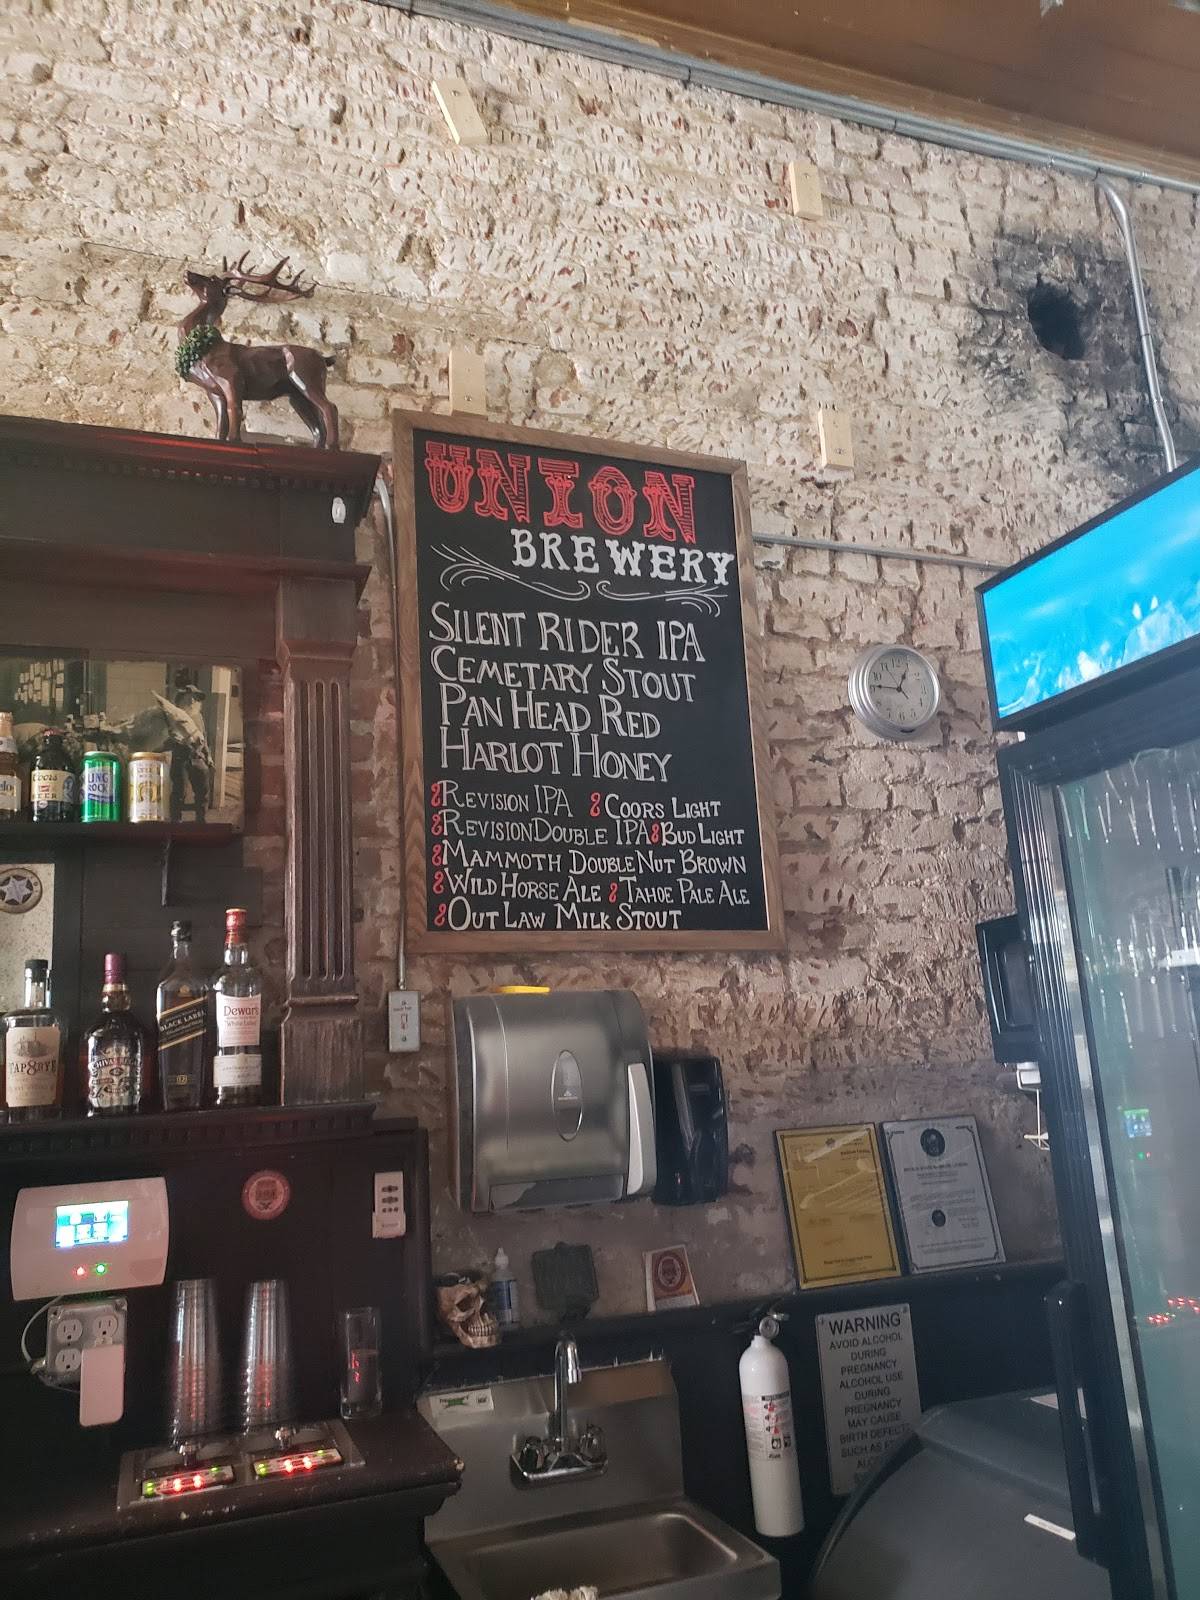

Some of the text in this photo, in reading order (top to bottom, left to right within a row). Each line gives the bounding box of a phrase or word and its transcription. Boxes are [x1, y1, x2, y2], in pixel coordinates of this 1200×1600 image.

[425, 441, 696, 544] UNION
[510, 528, 734, 586] BREWERY
[429, 601, 706, 662] SILENT RIDER IPA
[430, 645, 697, 702] CEMETARY STOUT
[440, 683, 661, 739] PAN HEAD RED
[440, 725, 673, 783] HARLOT HONEY
[440, 780, 573, 818] REVISION IPA
[604, 793, 722, 819] COORS LIGHT
[442, 808, 650, 845] REVISION DOUBLE IPA
[661, 824, 745, 845] BUD LIGHT
[442, 839, 747, 875] MAMMOTH DOUBLE NUT BROWN
[445, 868, 602, 902] WILD HORSE ALE
[618, 876, 750, 905] TAHOE PALE ALE
[447, 896, 682, 931] OUT LAW MILK STOUT
[829, 1312, 901, 1336] WARNING
[829, 1332, 903, 1350] AVOID ALCOHOL
[851, 1347, 887, 1361] DURING
[840, 1371, 904, 1389] ALCOHOL USE
[841, 1360, 897, 1376] PREGNANCY
[855, 1386, 891, 1400] DURING
[845, 1398, 902, 1416] PREGNANCY
[848, 1412, 900, 1428] MAY CAUSE
[840, 1430, 868, 1444] BIRTH
[841, 1445, 868, 1458] SUCH
[870, 1442, 882, 1452] AS
